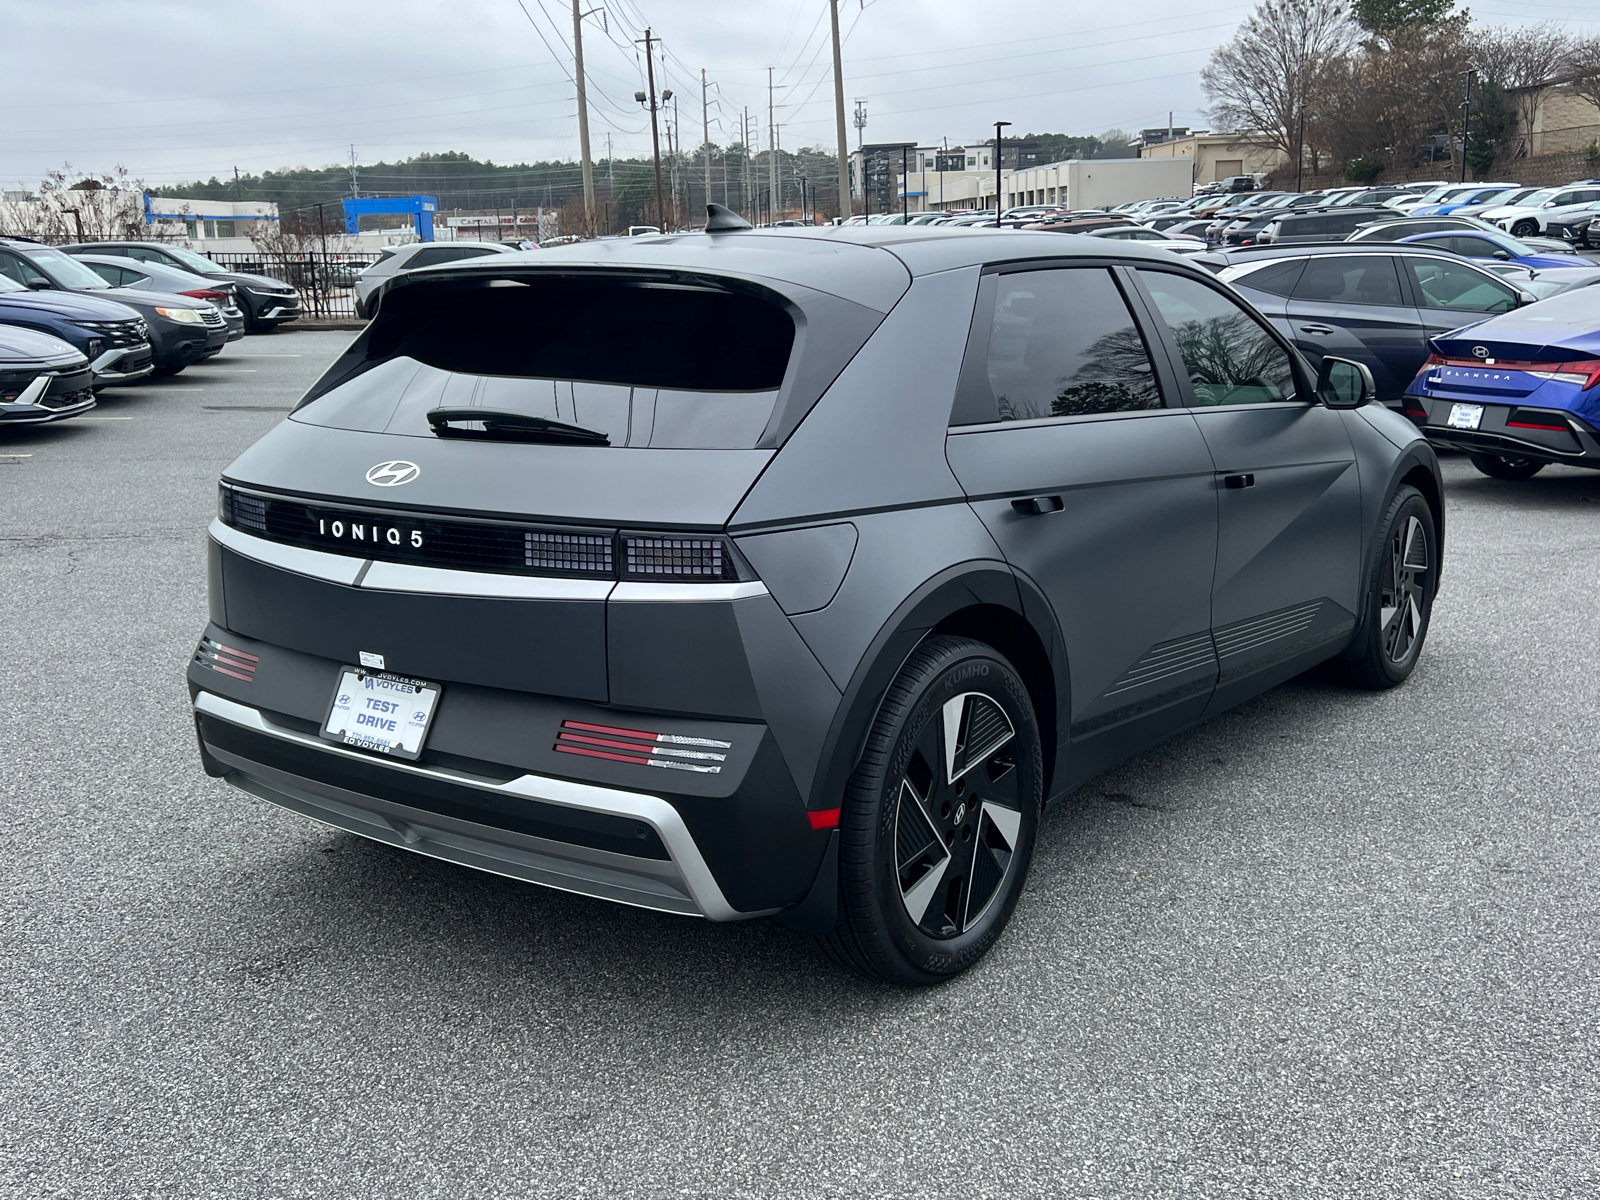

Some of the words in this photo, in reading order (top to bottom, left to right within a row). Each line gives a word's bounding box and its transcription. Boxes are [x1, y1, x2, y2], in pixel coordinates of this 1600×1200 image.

[1446, 370, 1510, 381] ELANTRA
[320, 519, 400, 545] IONIQ
[410, 530, 422, 548] 5
[376, 678, 414, 694] VOYLES
[943, 664, 989, 691] KUMHO
[366, 697, 399, 715] TEST
[356, 712, 397, 732] DRIVE
[343, 736, 355, 745] ED
[357, 740, 391, 753] VOYLES
